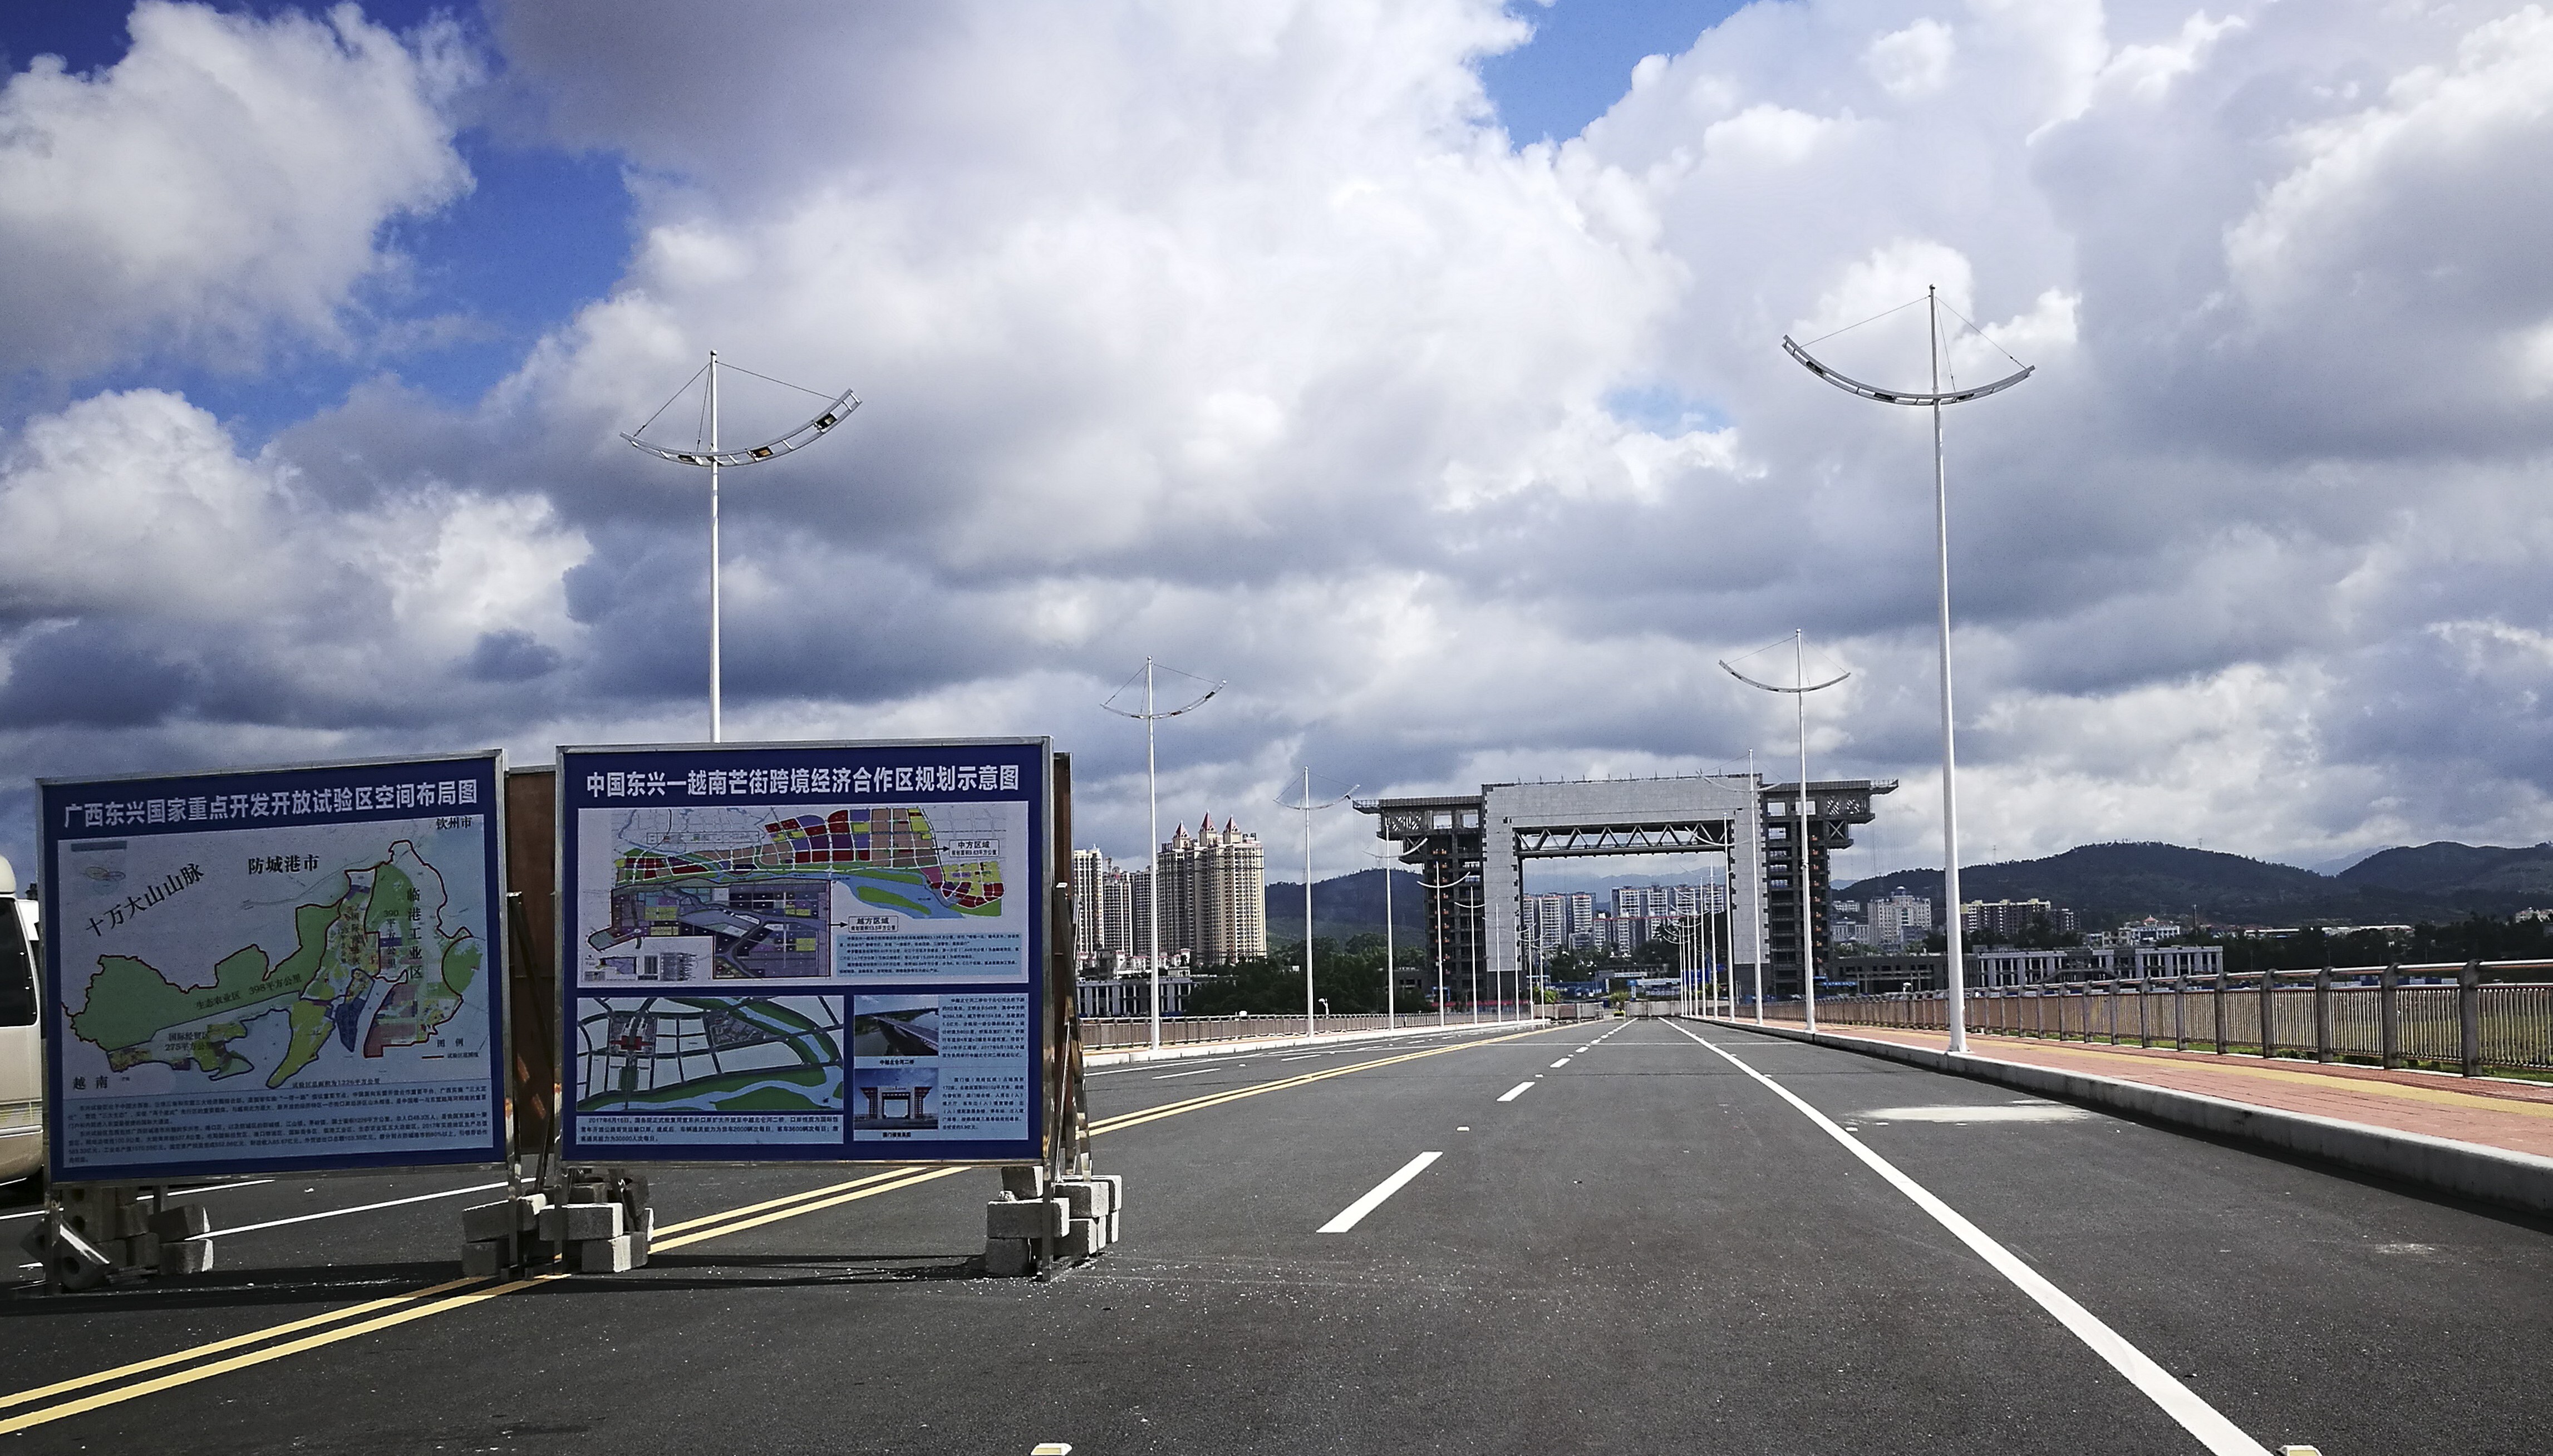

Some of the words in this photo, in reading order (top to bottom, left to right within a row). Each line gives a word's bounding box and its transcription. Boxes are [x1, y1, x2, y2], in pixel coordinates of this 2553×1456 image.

[65, 779, 477, 828] 广西东兴国家重点开发开放试验区空间布局图
[436, 816, 472, 830] 钦州市
[957, 840, 990, 849] 中方区域
[249, 855, 319, 874] 防城港市
[86, 863, 204, 937] 十万大山山脉
[407, 887, 423, 978] 临港工业区
[197, 991, 240, 1010] 生态农业区
[249, 974, 302, 995] 398平方公里
[73, 1077, 86, 1090] 越
[96, 1075, 108, 1089] 南
